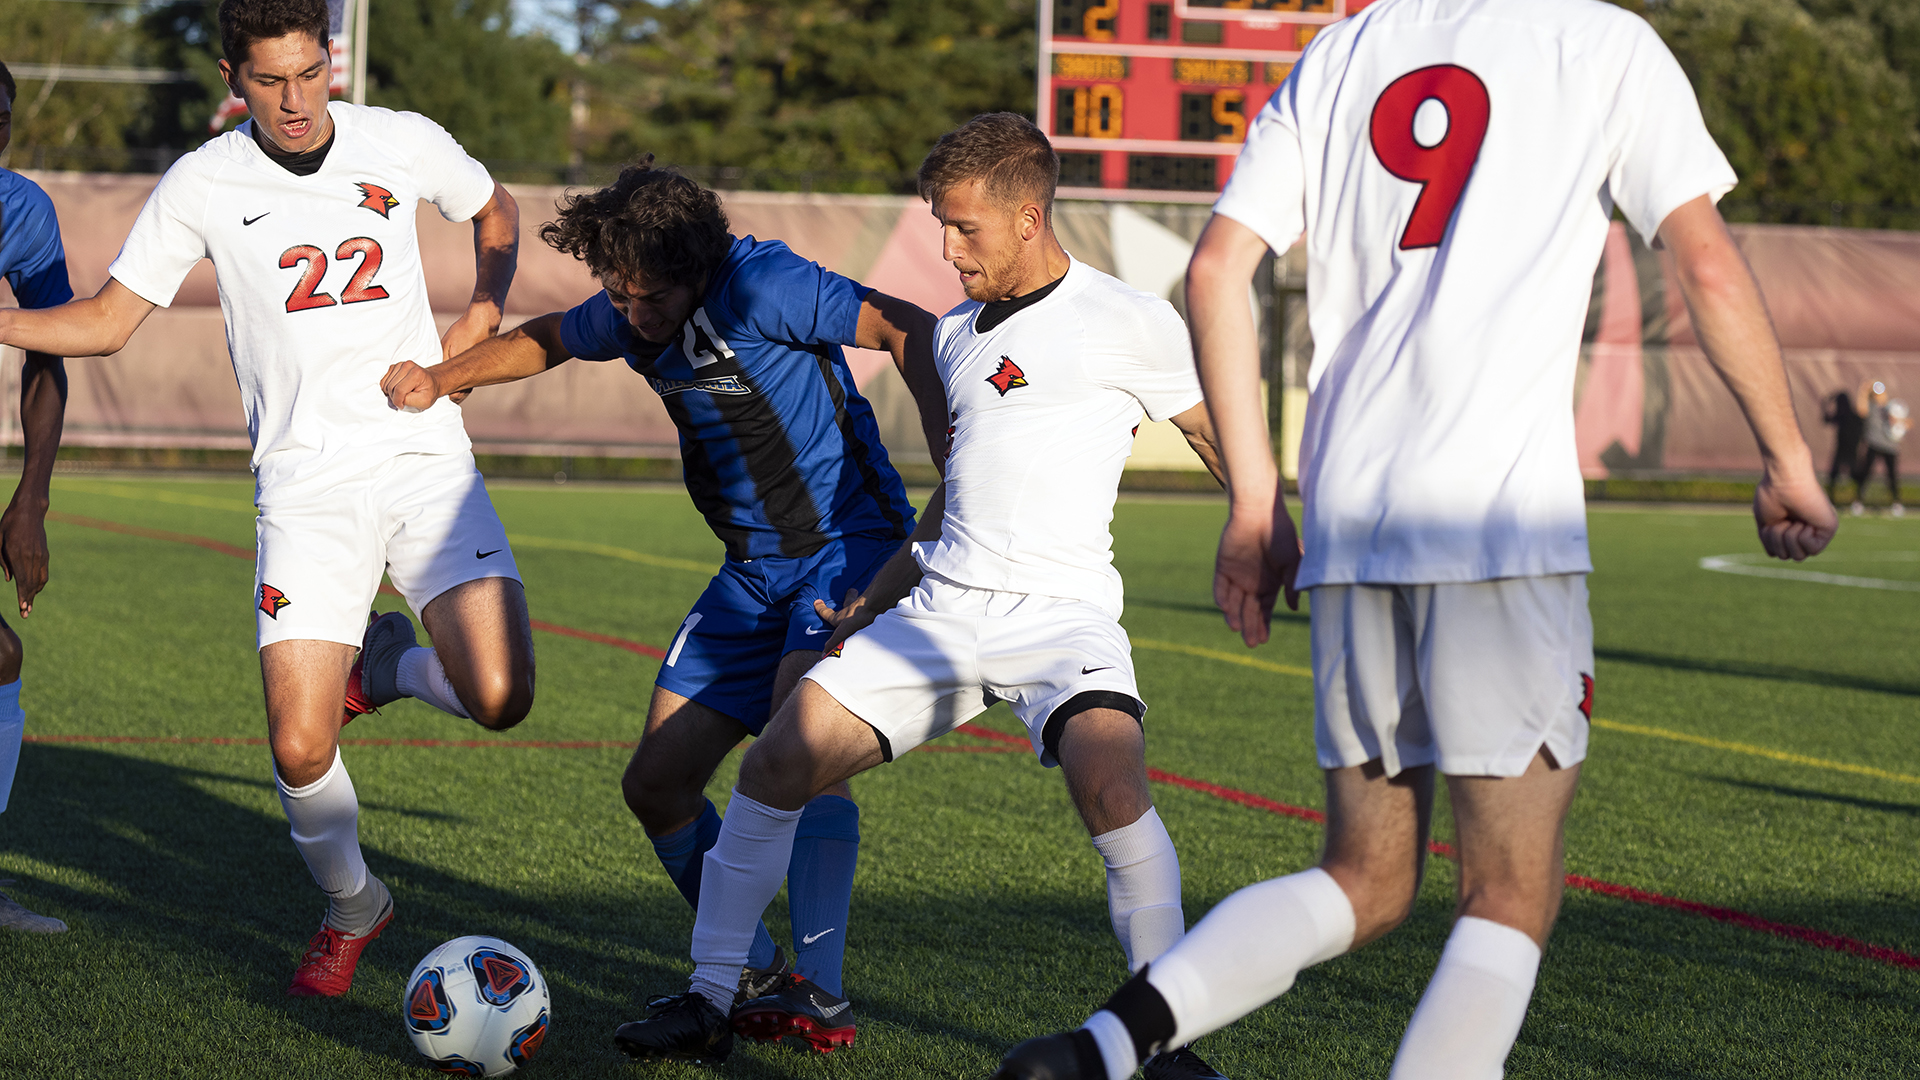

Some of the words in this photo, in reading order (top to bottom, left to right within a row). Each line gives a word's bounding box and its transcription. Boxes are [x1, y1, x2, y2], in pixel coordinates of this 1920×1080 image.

[1073, 84, 1123, 138] 10
[1211, 89, 1246, 143] 5
[1369, 63, 1491, 251] 9
[278, 236, 390, 314] 22
[682, 306, 736, 370] 21
